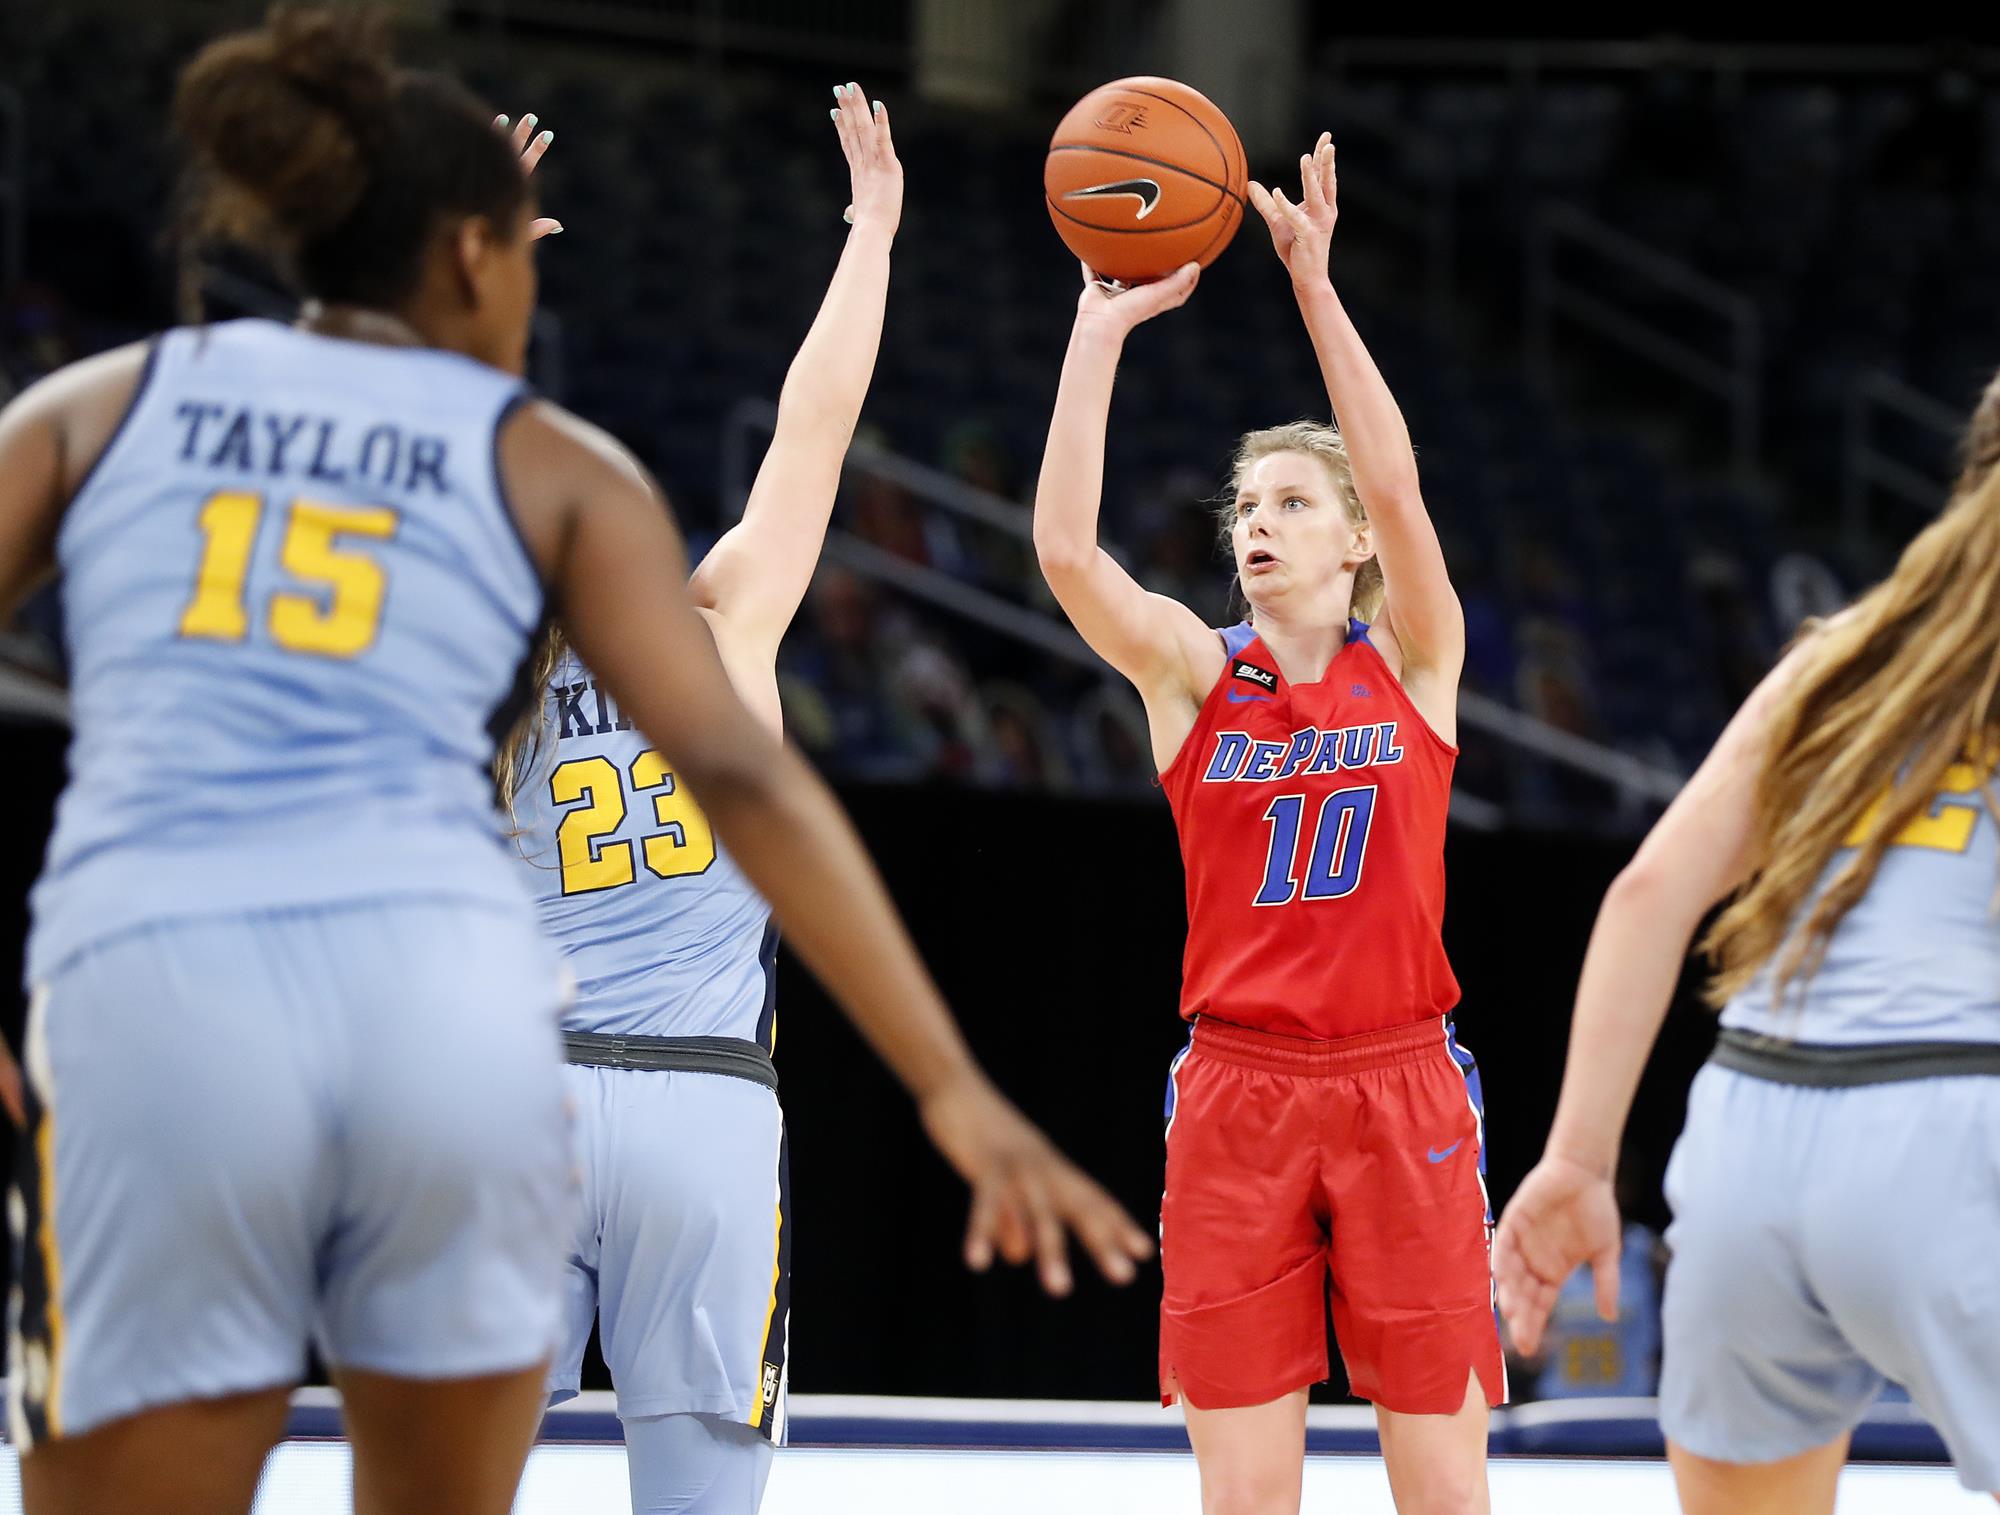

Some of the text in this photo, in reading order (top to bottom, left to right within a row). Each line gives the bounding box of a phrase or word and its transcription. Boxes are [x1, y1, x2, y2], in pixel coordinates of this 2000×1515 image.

[176, 402, 450, 493] TAYLOR
[178, 489, 398, 659] 15
[555, 680, 631, 740] KI
[1238, 664, 1274, 683] BLM
[550, 749, 717, 897] 23
[1251, 785, 1378, 907] 10
